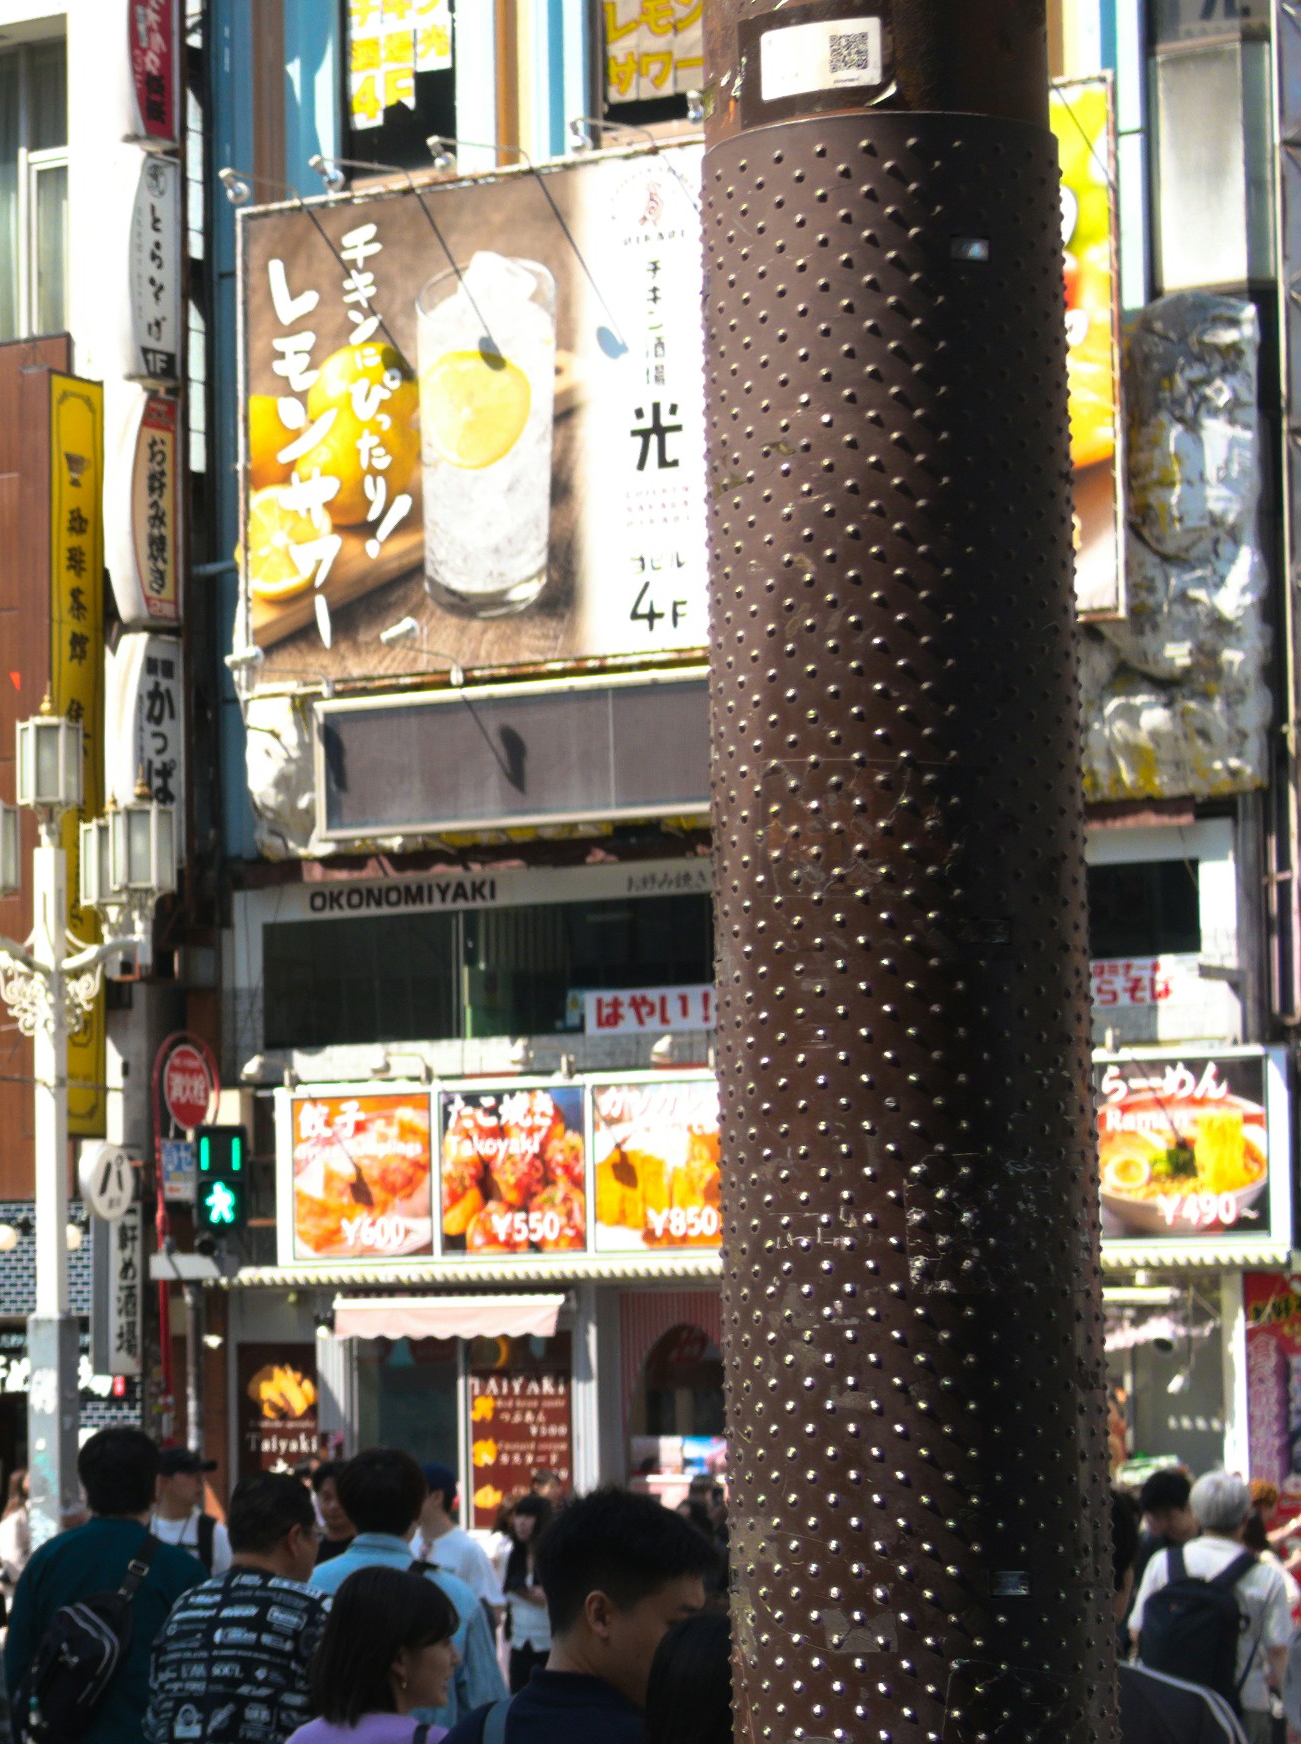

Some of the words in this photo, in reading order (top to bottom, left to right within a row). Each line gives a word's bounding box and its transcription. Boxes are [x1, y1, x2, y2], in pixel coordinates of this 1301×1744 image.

[349, 76, 416, 131] 4F
[340, 222, 414, 561] チキンにぴったり!
[267, 258, 342, 650] レモンサワー
[630, 401, 683, 472] 光
[146, 436, 168, 596] お好み焼き
[630, 581, 687, 632] 4F
[308, 877, 498, 914] OKONOMIYAKI
[595, 987, 714, 1029] はやい!
[168, 1071, 208, 1108] 消火栓
[1101, 1060, 1231, 1104] らーめん
[298, 1098, 365, 1138] 餃子
[446, 1090, 555, 1134] たこ焼き
[249, 1433, 319, 1455] Taiyaki
